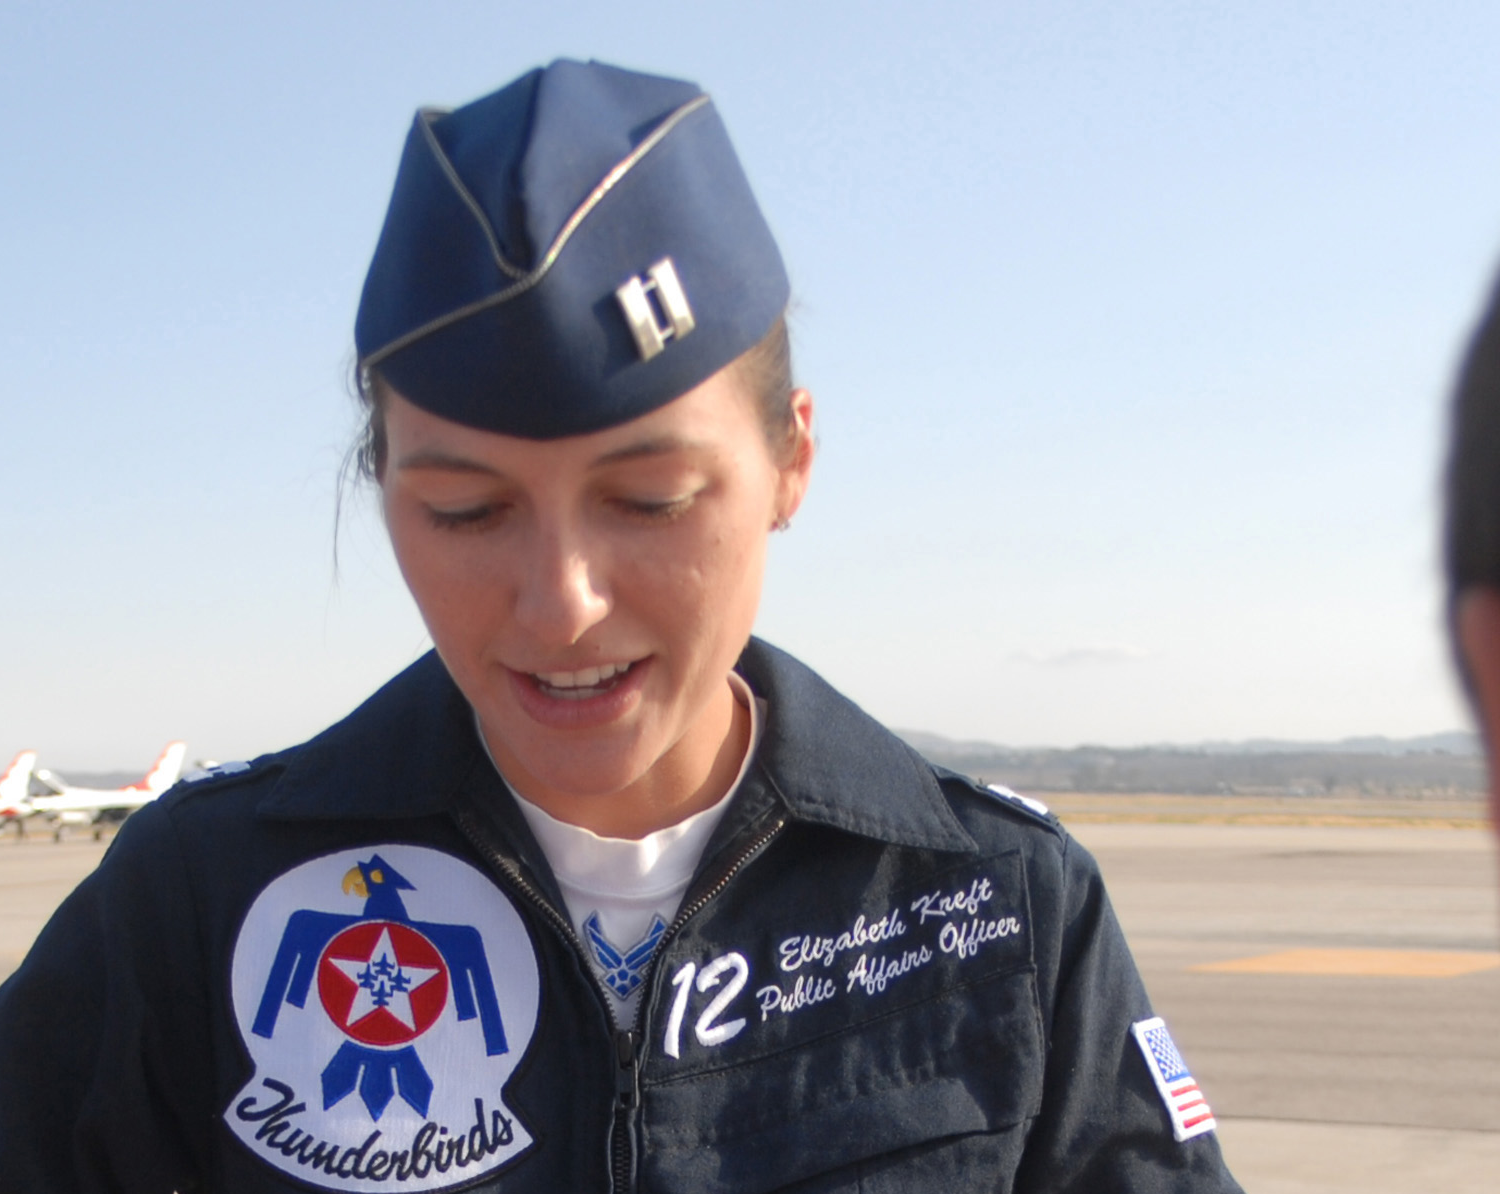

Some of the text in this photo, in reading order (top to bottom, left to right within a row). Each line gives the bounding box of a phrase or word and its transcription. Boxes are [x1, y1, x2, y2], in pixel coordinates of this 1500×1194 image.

[756, 916, 1021, 1022] Public Affairs Officer
[779, 878, 993, 972] Elizabeth Kreft
[664, 952, 749, 1059] 12
[236, 1078, 513, 1181] Thunderbirds
